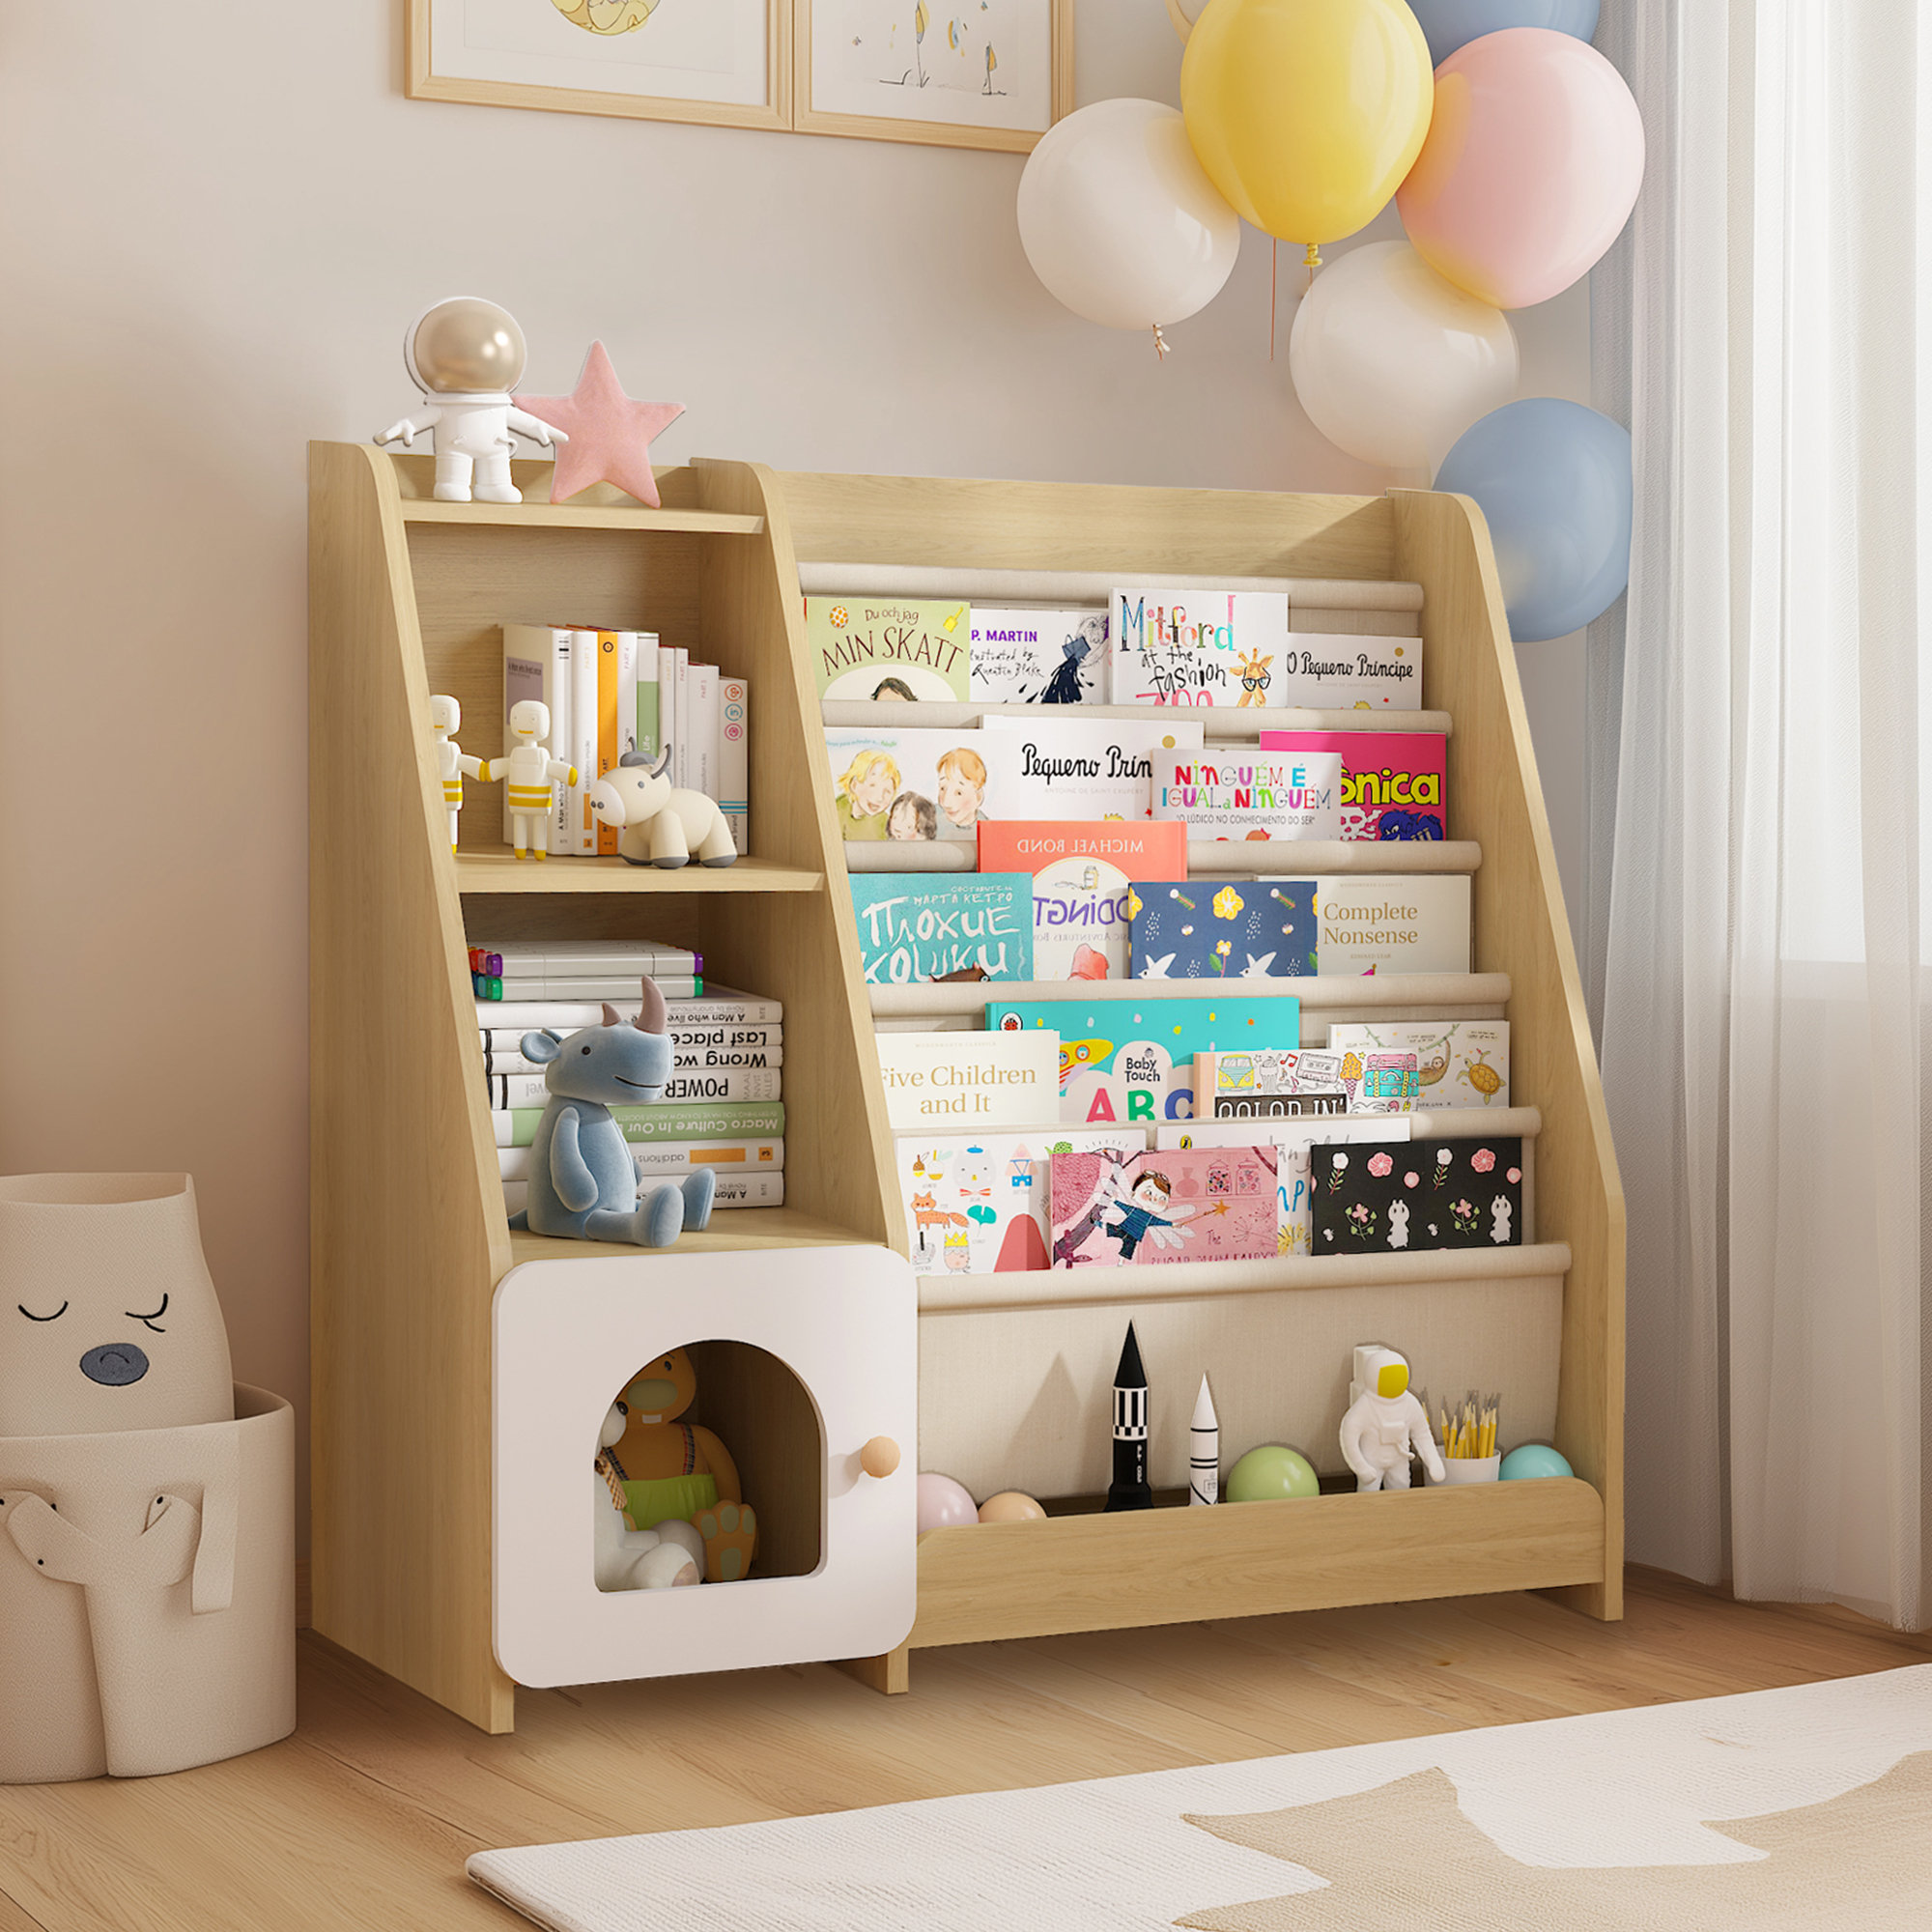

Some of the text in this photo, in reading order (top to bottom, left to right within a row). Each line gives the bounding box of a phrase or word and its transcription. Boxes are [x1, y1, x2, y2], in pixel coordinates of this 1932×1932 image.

[865, 607, 919, 625] Du och jag
[1120, 594, 1236, 652] Mitford
[971, 629, 1037, 642] P. MARTIN
[822, 626, 964, 677] MIN SKATT
[1166, 645, 1193, 665] the
[1287, 651, 1297, 673] O
[1300, 651, 1354, 681] Pequeno
[1149, 658, 1227, 702] fashion
[1022, 743, 1100, 785] Pequeno
[1292, 763, 1306, 787] É
[1222, 798, 1231, 810] a
[1216, 814, 1228, 824] NO
[1230, 814, 1287, 825] CONHECIMENTO
[1288, 815, 1299, 825] DO
[913, 892, 1012, 906] МАРТА КЕТРО
[1323, 901, 1418, 924] Complete
[1323, 926, 1418, 945] Nonsense
[730, 1031, 767, 1046] Last
[705, 1050, 767, 1067] Wrong
[1126, 1057, 1156, 1071] Baby
[930, 1065, 1037, 1087] Children
[1124, 1069, 1160, 1083] Touch
[920, 1093, 991, 1114] and It
[628, 1119, 778, 1134] Macro Culture In Our
[715, 1190, 747, 1200] A Man
[1206, 1229, 1221, 1244] The
